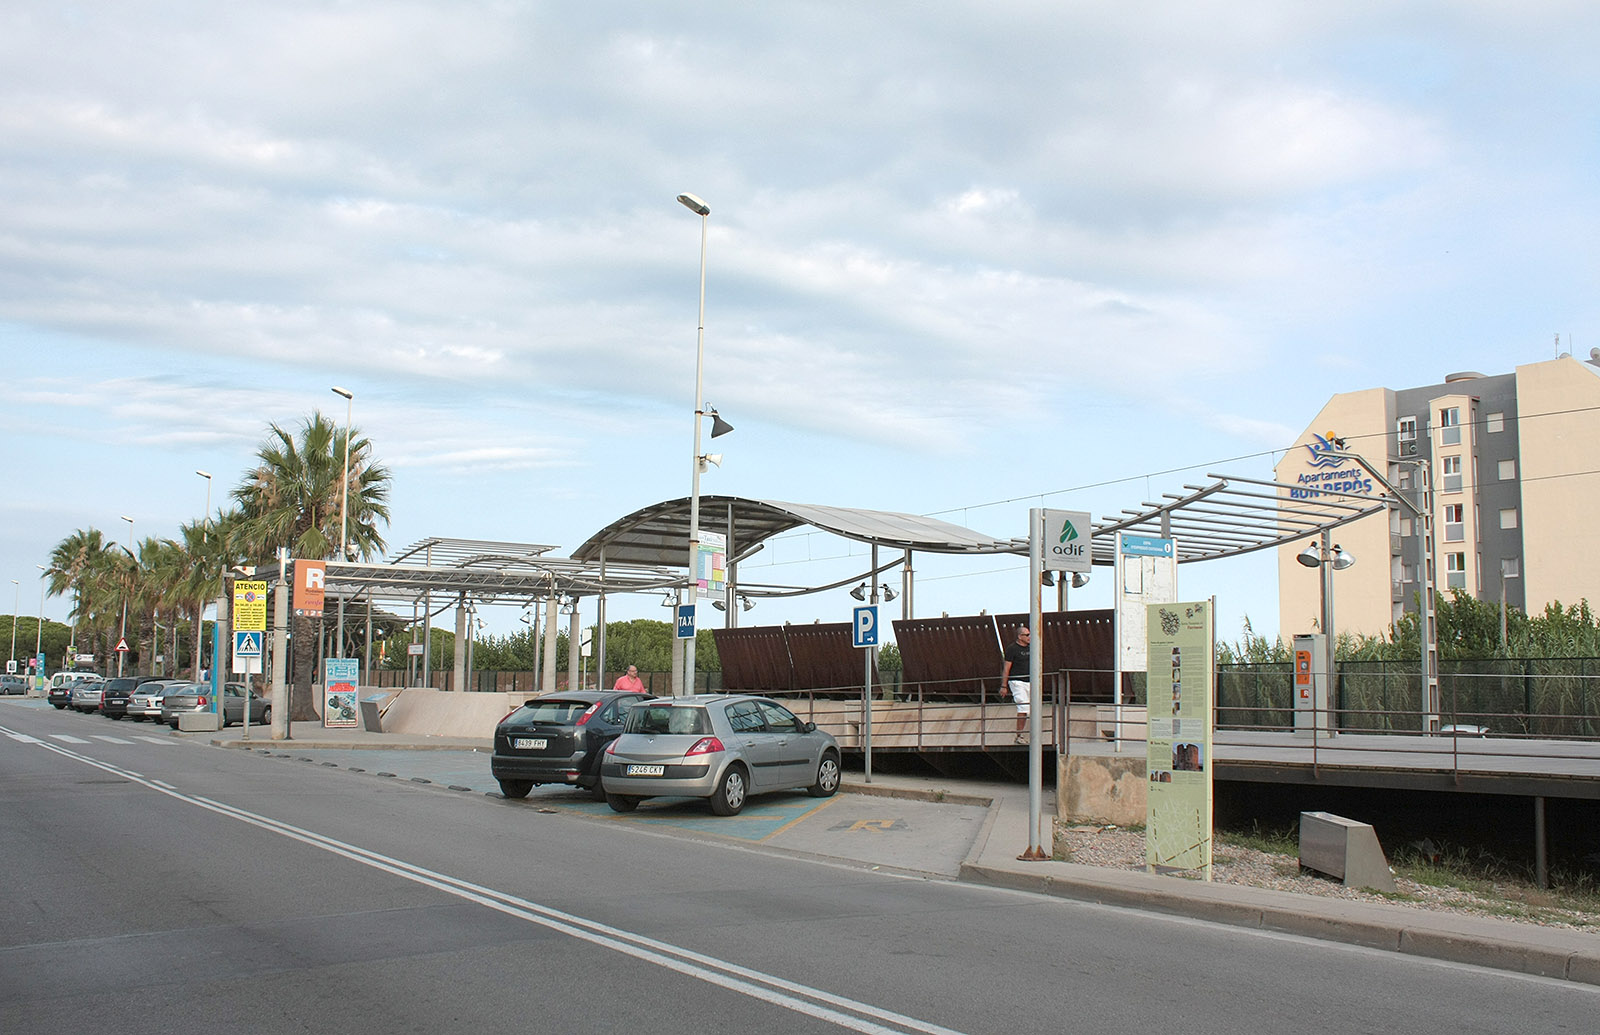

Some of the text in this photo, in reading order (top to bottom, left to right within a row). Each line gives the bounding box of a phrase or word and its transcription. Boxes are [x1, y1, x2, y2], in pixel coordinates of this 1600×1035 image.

[1297, 468, 1362, 484] Apartaments
[1052, 543, 1085, 556] adif
[306, 567, 325, 589] R
[678, 615, 696, 627] TAXI
[858, 609, 874, 643] P
[631, 765, 663, 774] 5246 CKY
